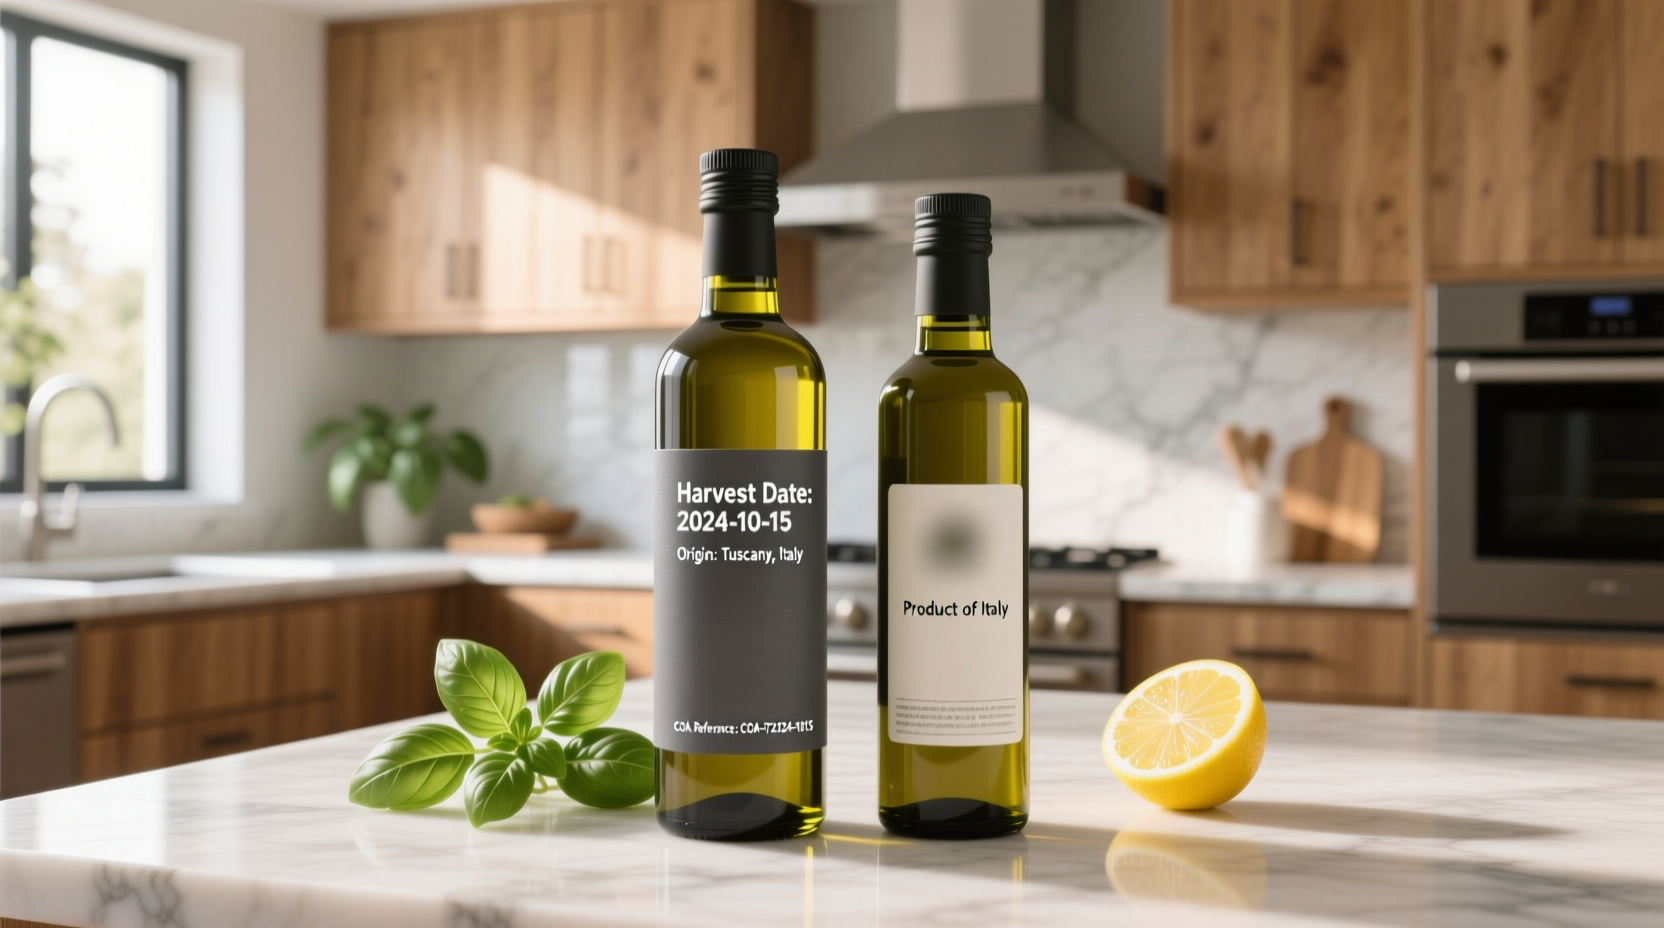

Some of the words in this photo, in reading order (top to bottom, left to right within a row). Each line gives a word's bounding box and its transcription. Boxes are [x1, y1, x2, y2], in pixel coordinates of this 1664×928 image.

[677, 481, 756, 504] Harvest
[762, 481, 813, 504] Date:
[677, 510, 792, 532] 2024-10-15
[677, 546, 717, 565] Origin:
[721, 547, 775, 565] Tuscany,
[779, 546, 804, 565] Italy
[903, 600, 958, 617] Product
[962, 600, 978, 617] of
[981, 599, 1009, 620] Italy
